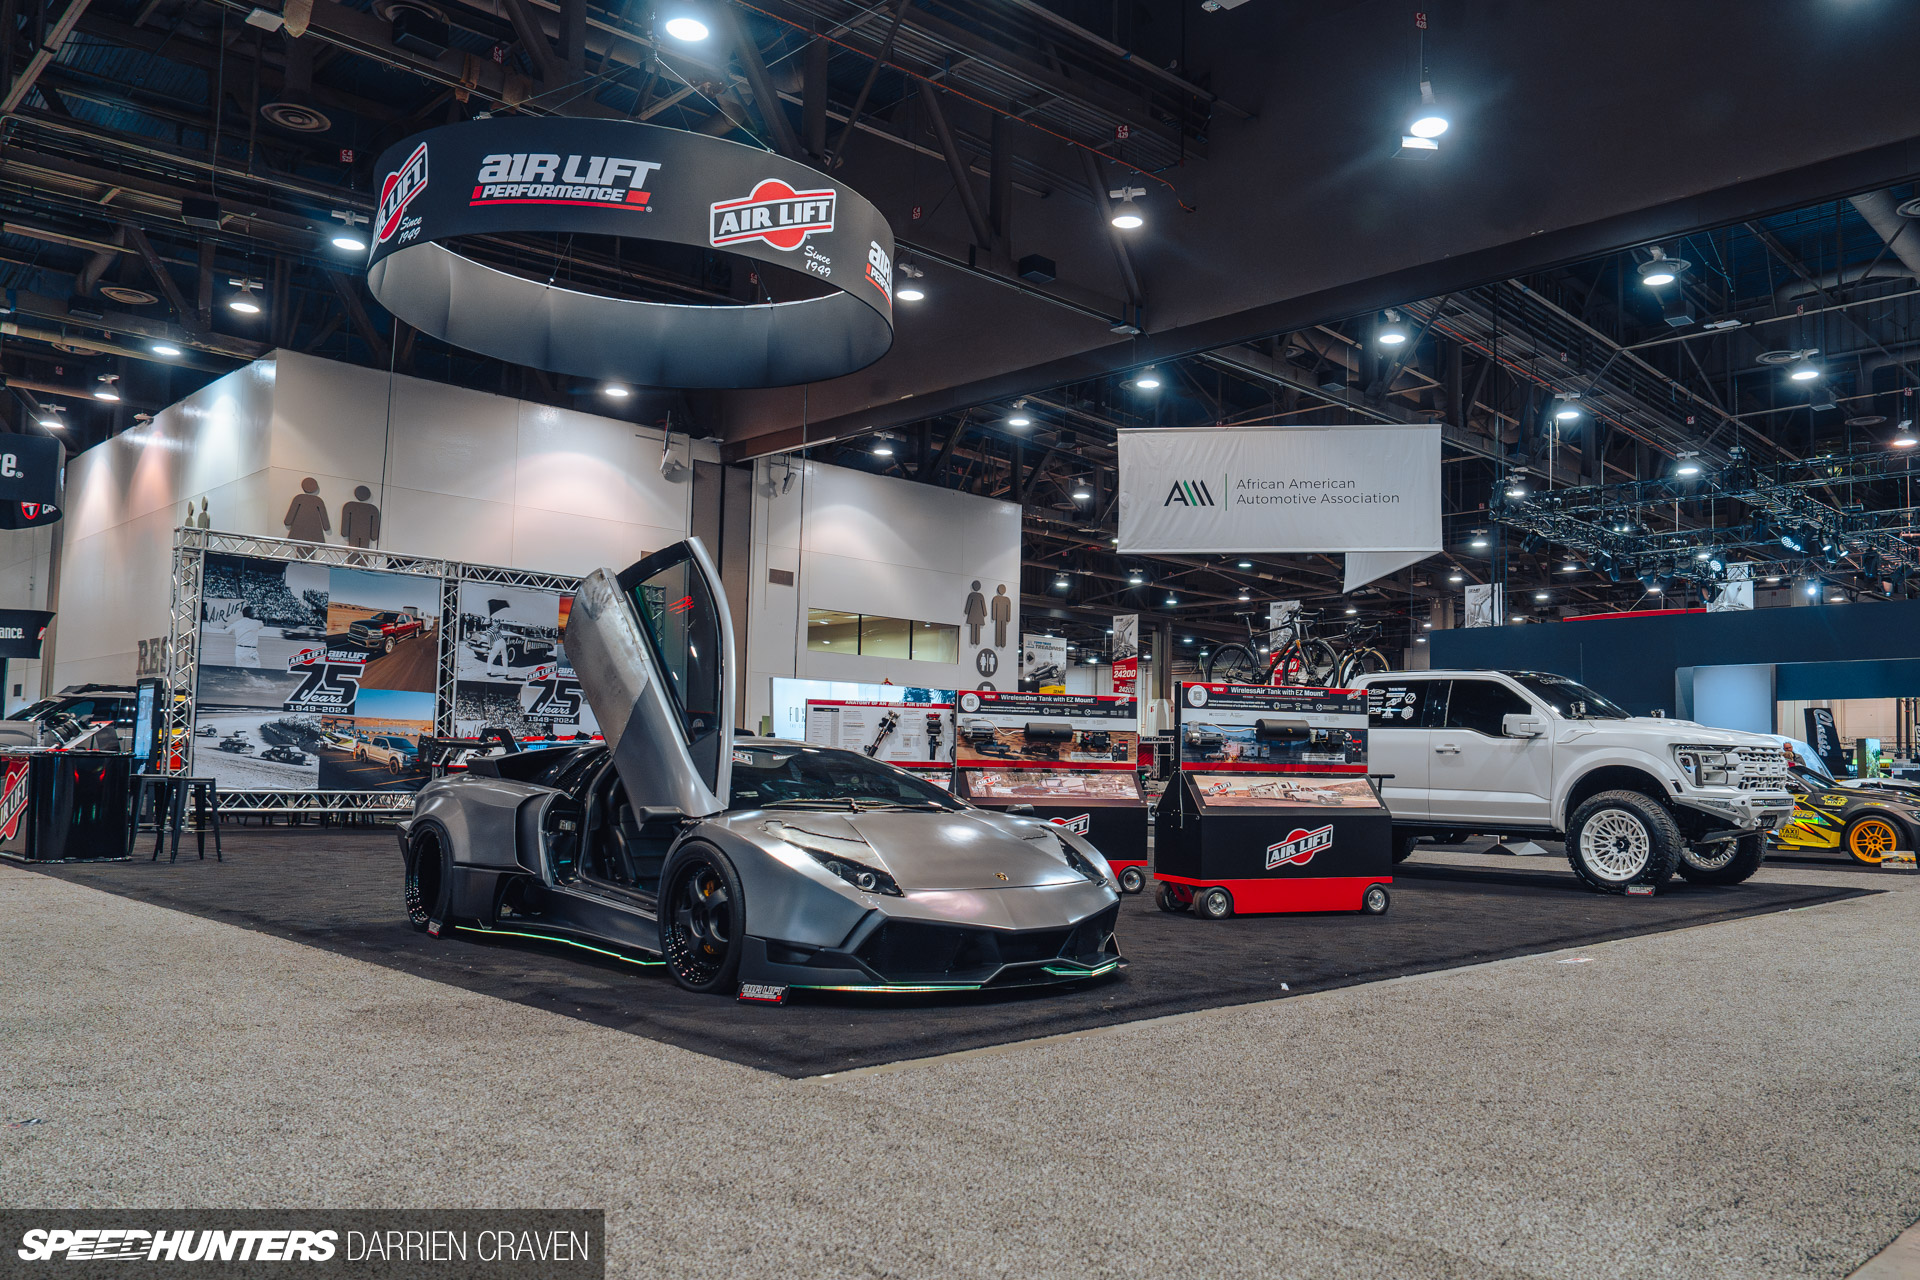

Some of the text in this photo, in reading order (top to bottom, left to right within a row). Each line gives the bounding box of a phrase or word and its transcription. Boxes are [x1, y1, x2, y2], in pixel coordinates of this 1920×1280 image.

[564, 154, 661, 189] LIFT
[389, 158, 423, 217] LIFT
[400, 217, 423, 231] Since
[719, 200, 831, 236] AIR LIFT
[398, 227, 421, 245] 1949
[804, 244, 832, 266] Since
[805, 259, 832, 278] 1949
[1236, 477, 1355, 491] African American
[1236, 492, 1400, 505] Automotive Association
[209, 601, 245, 623] AIR LIFT
[290, 649, 326, 666] AIR LIFT
[348, 652, 370, 660] LIFT
[528, 670, 540, 680] AIR
[541, 666, 556, 676] LIFT
[1114, 670, 1136, 678] 24200
[286, 664, 364, 706] 75
[1230, 686, 1266, 694] WirelessAir
[300, 689, 343, 706] Years
[526, 680, 583, 717] 75
[1000, 694, 1038, 702] WirelessOne
[536, 703, 570, 716] Years
[1813, 708, 1833, 757] Classic
[10, 776, 26, 814] LIFT
[1270, 831, 1330, 863] AIR LIFT
